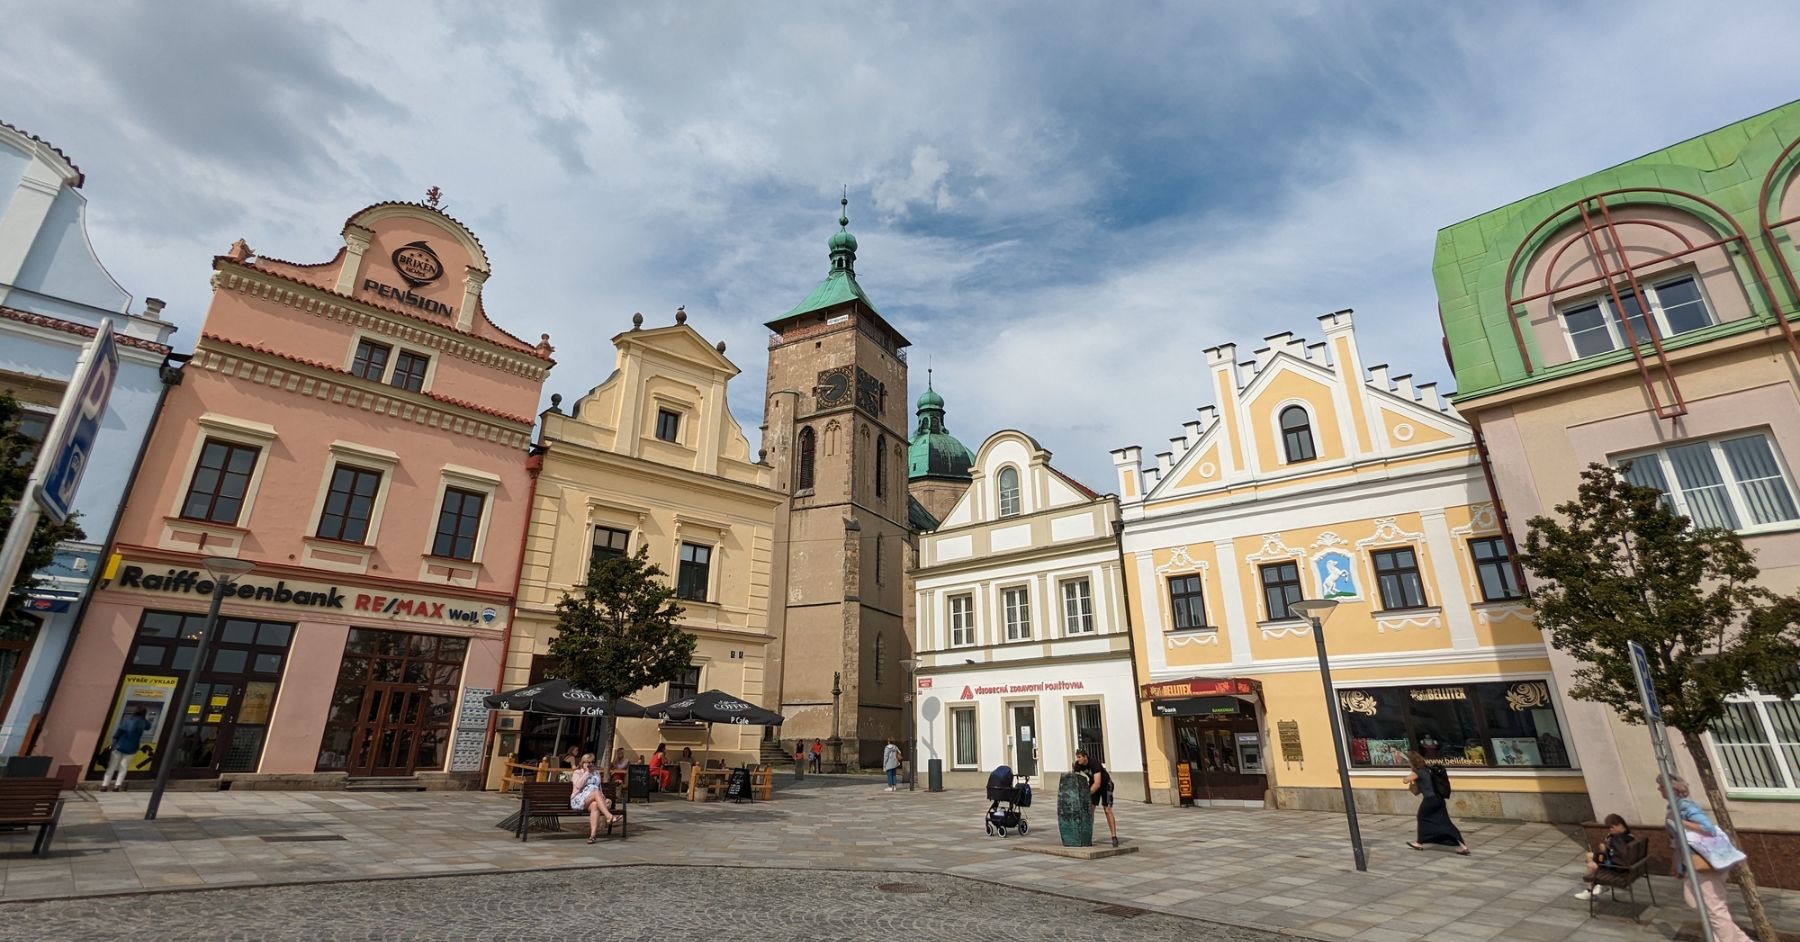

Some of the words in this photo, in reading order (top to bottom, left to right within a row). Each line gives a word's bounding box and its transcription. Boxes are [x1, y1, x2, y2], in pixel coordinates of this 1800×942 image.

[399, 254, 437, 274] BRIXEN
[364, 279, 453, 316] PENSION
[69, 353, 111, 447] P
[119, 565, 345, 609] Raiffesenbank
[355, 594, 445, 619] RE/MAX
[580, 706, 586, 715] P
